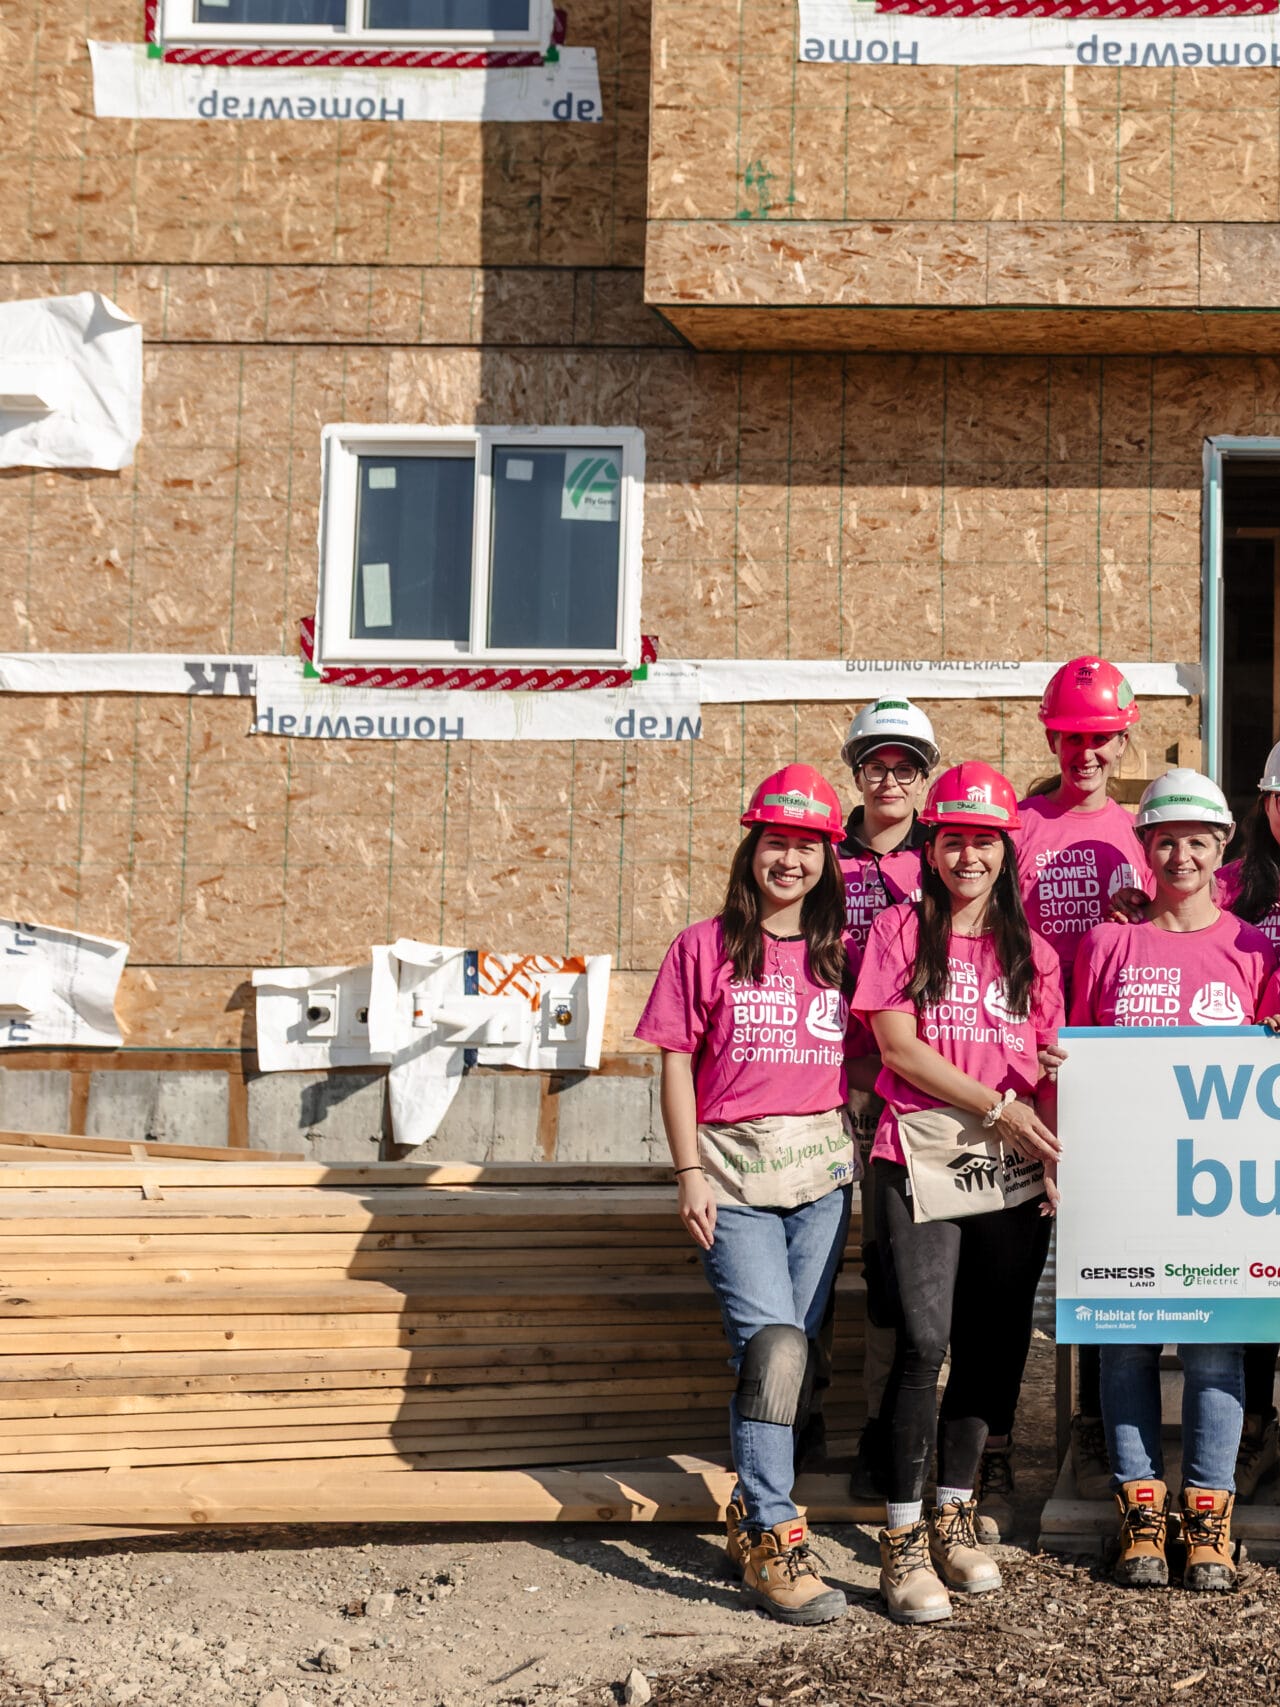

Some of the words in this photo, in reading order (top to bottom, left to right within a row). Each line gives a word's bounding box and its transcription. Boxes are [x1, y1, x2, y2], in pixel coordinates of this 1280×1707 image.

[1036, 849, 1096, 866] strong
[1036, 866, 1098, 881] WOMEN
[1039, 880, 1100, 900] BUILD
[1040, 899, 1101, 917] strong
[1119, 964, 1181, 985] strong
[732, 990, 797, 1006] WOMEN
[1117, 983, 1180, 998] WOMEN
[1115, 996, 1181, 1016] BUILD
[733, 1005, 798, 1026] BUILD
[732, 1023, 797, 1048] strong
[722, 1151, 767, 1175] What
[796, 1142, 825, 1169] you
[1080, 1266, 1155, 1280] GENESIS
[1164, 1263, 1240, 1278] Schneider
[1196, 1277, 1239, 1286] Electric
[1094, 1309, 1136, 1322] Habitat
[1138, 1309, 1154, 1321] for
[1156, 1309, 1211, 1324] Humanity
